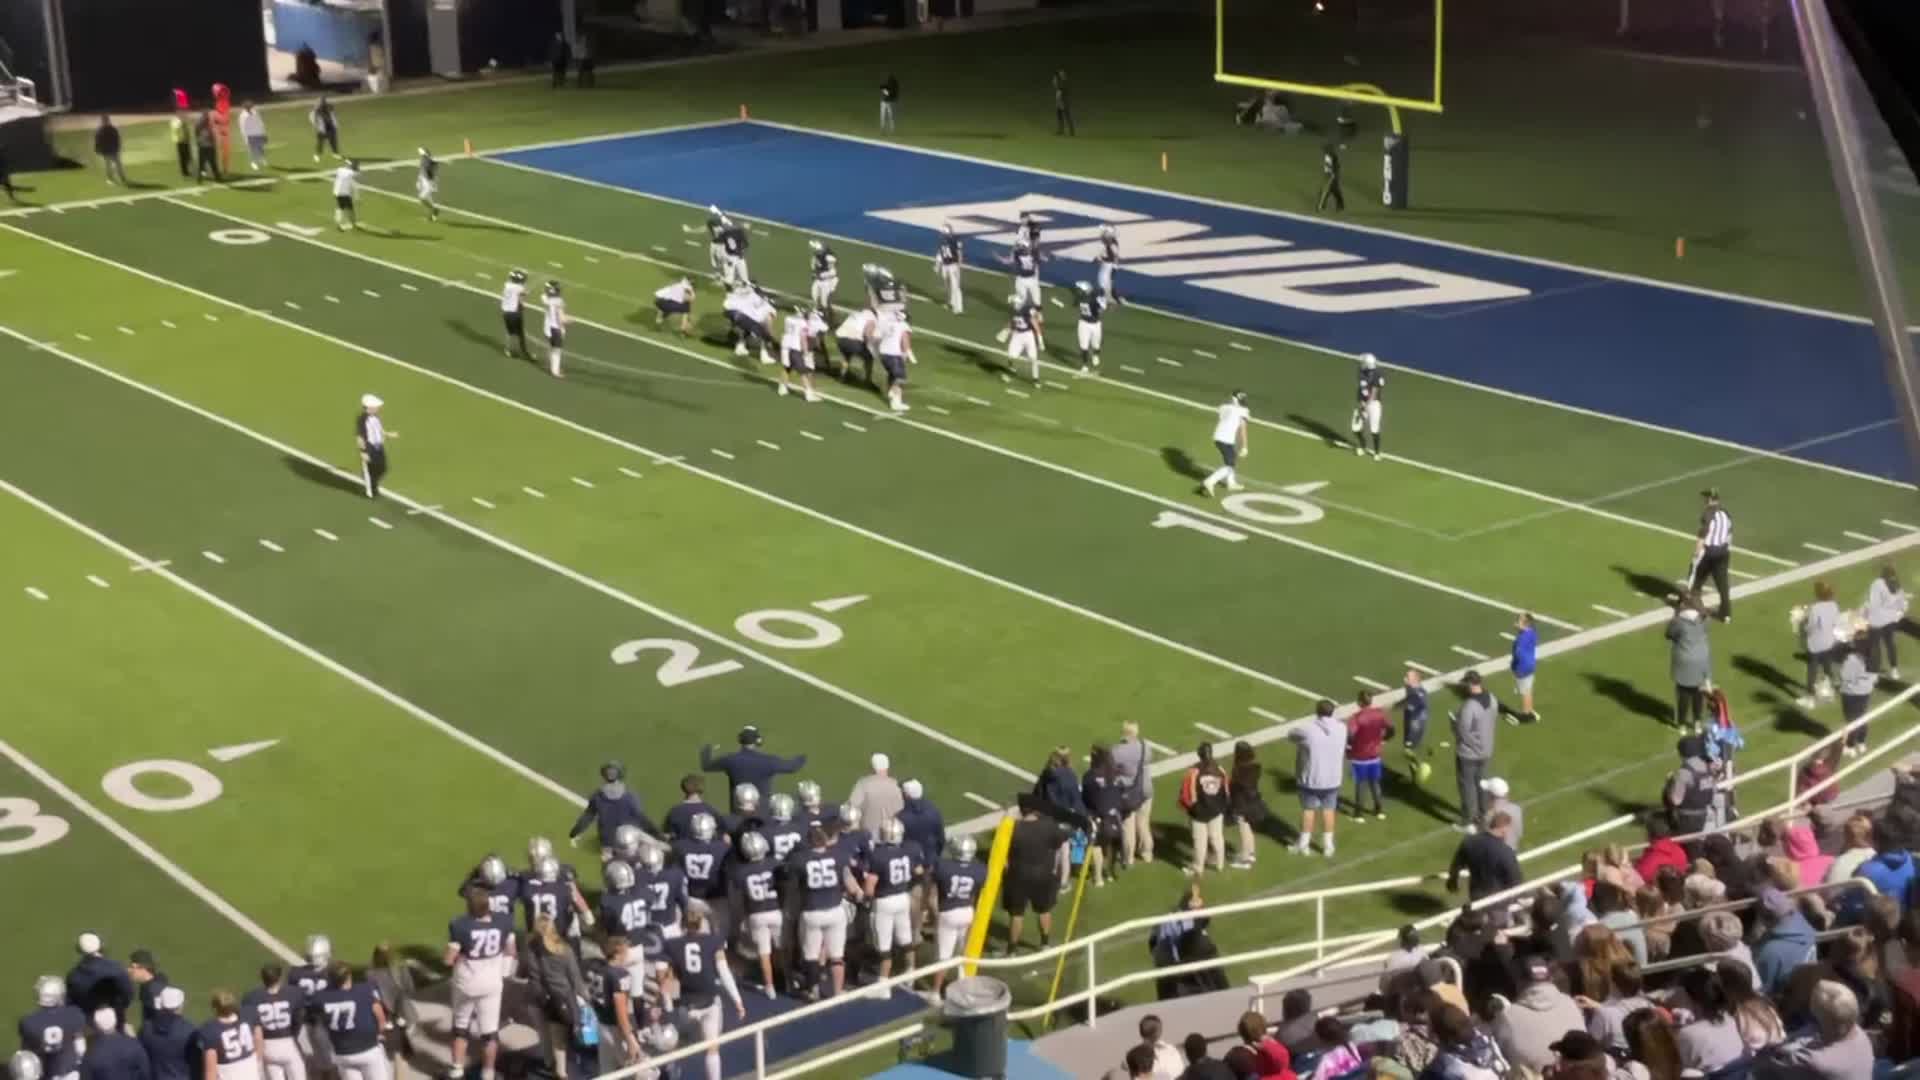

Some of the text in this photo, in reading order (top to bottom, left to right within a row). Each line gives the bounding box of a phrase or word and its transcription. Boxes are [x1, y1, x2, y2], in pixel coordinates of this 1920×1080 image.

[1152, 492, 1324, 542] 10
[611, 609, 843, 687] 20
[685, 853, 713, 879] 67
[806, 859, 838, 889] 65
[889, 856, 912, 885] 61
[621, 899, 647, 931] 45
[470, 928, 501, 957] 78
[685, 943, 701, 972] 6
[257, 1001, 291, 1030] 25
[324, 1001, 356, 1030] 77
[221, 1022, 253, 1059] 54
